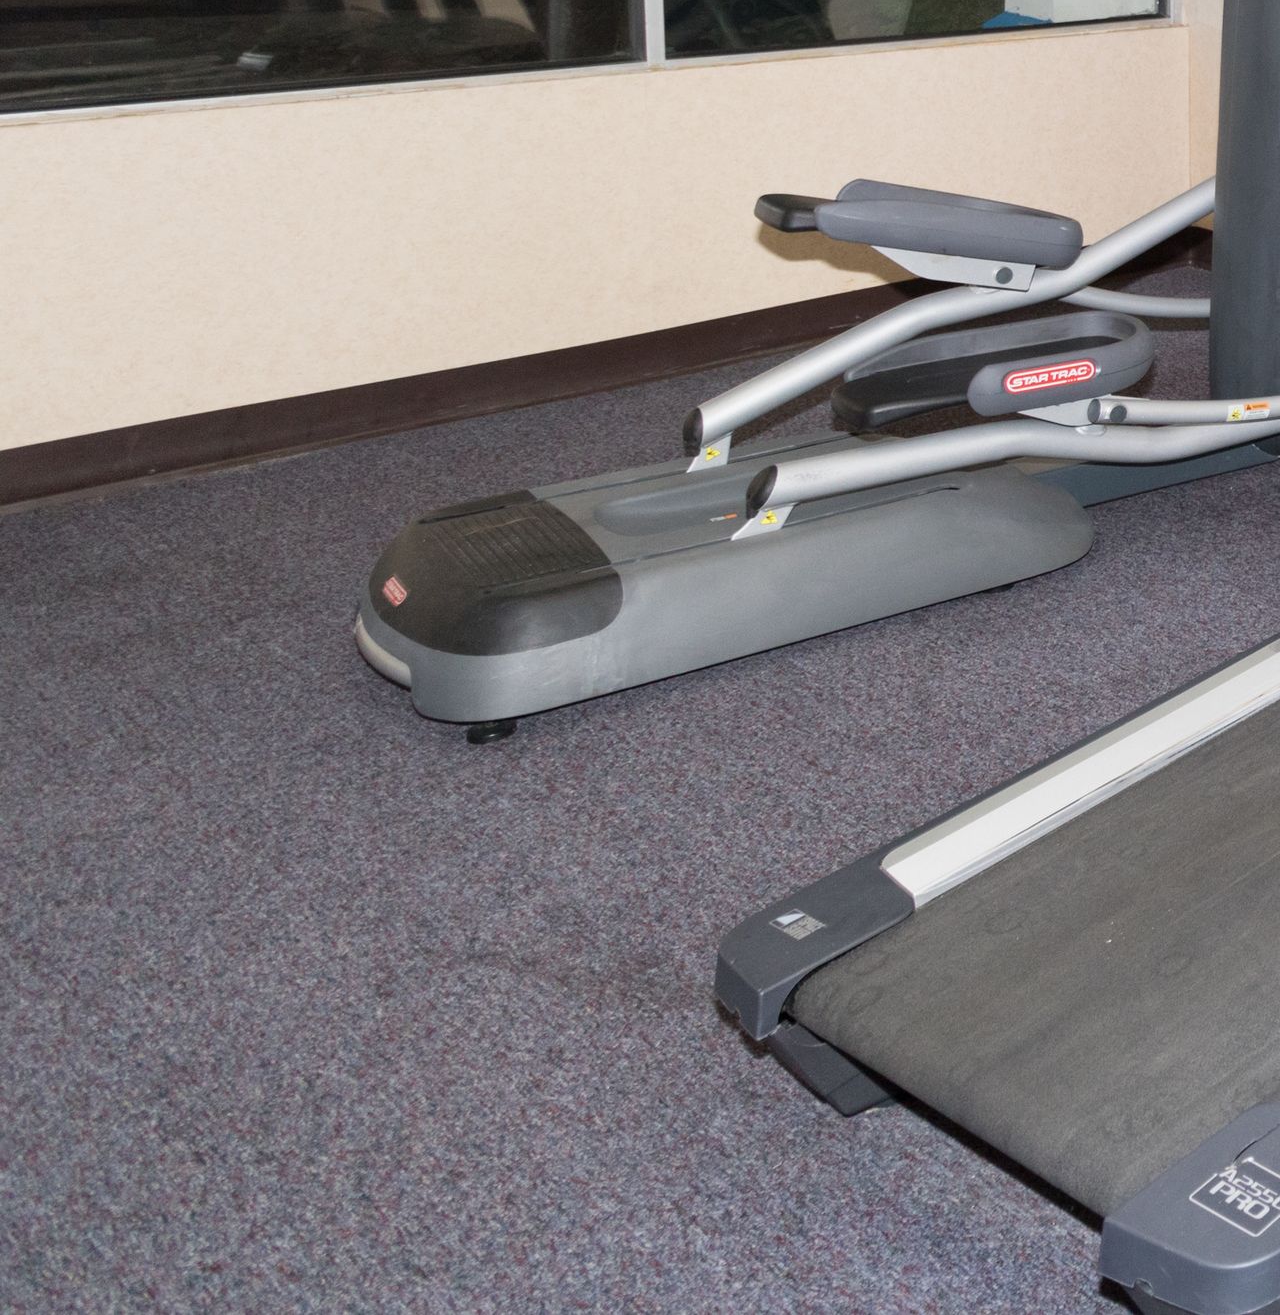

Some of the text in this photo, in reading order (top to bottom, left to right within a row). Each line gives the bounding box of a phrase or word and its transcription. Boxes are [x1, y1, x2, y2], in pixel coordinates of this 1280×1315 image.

[1012, 366, 1088, 387] STAR TRAC
[1210, 1180, 1270, 1220] PRO
